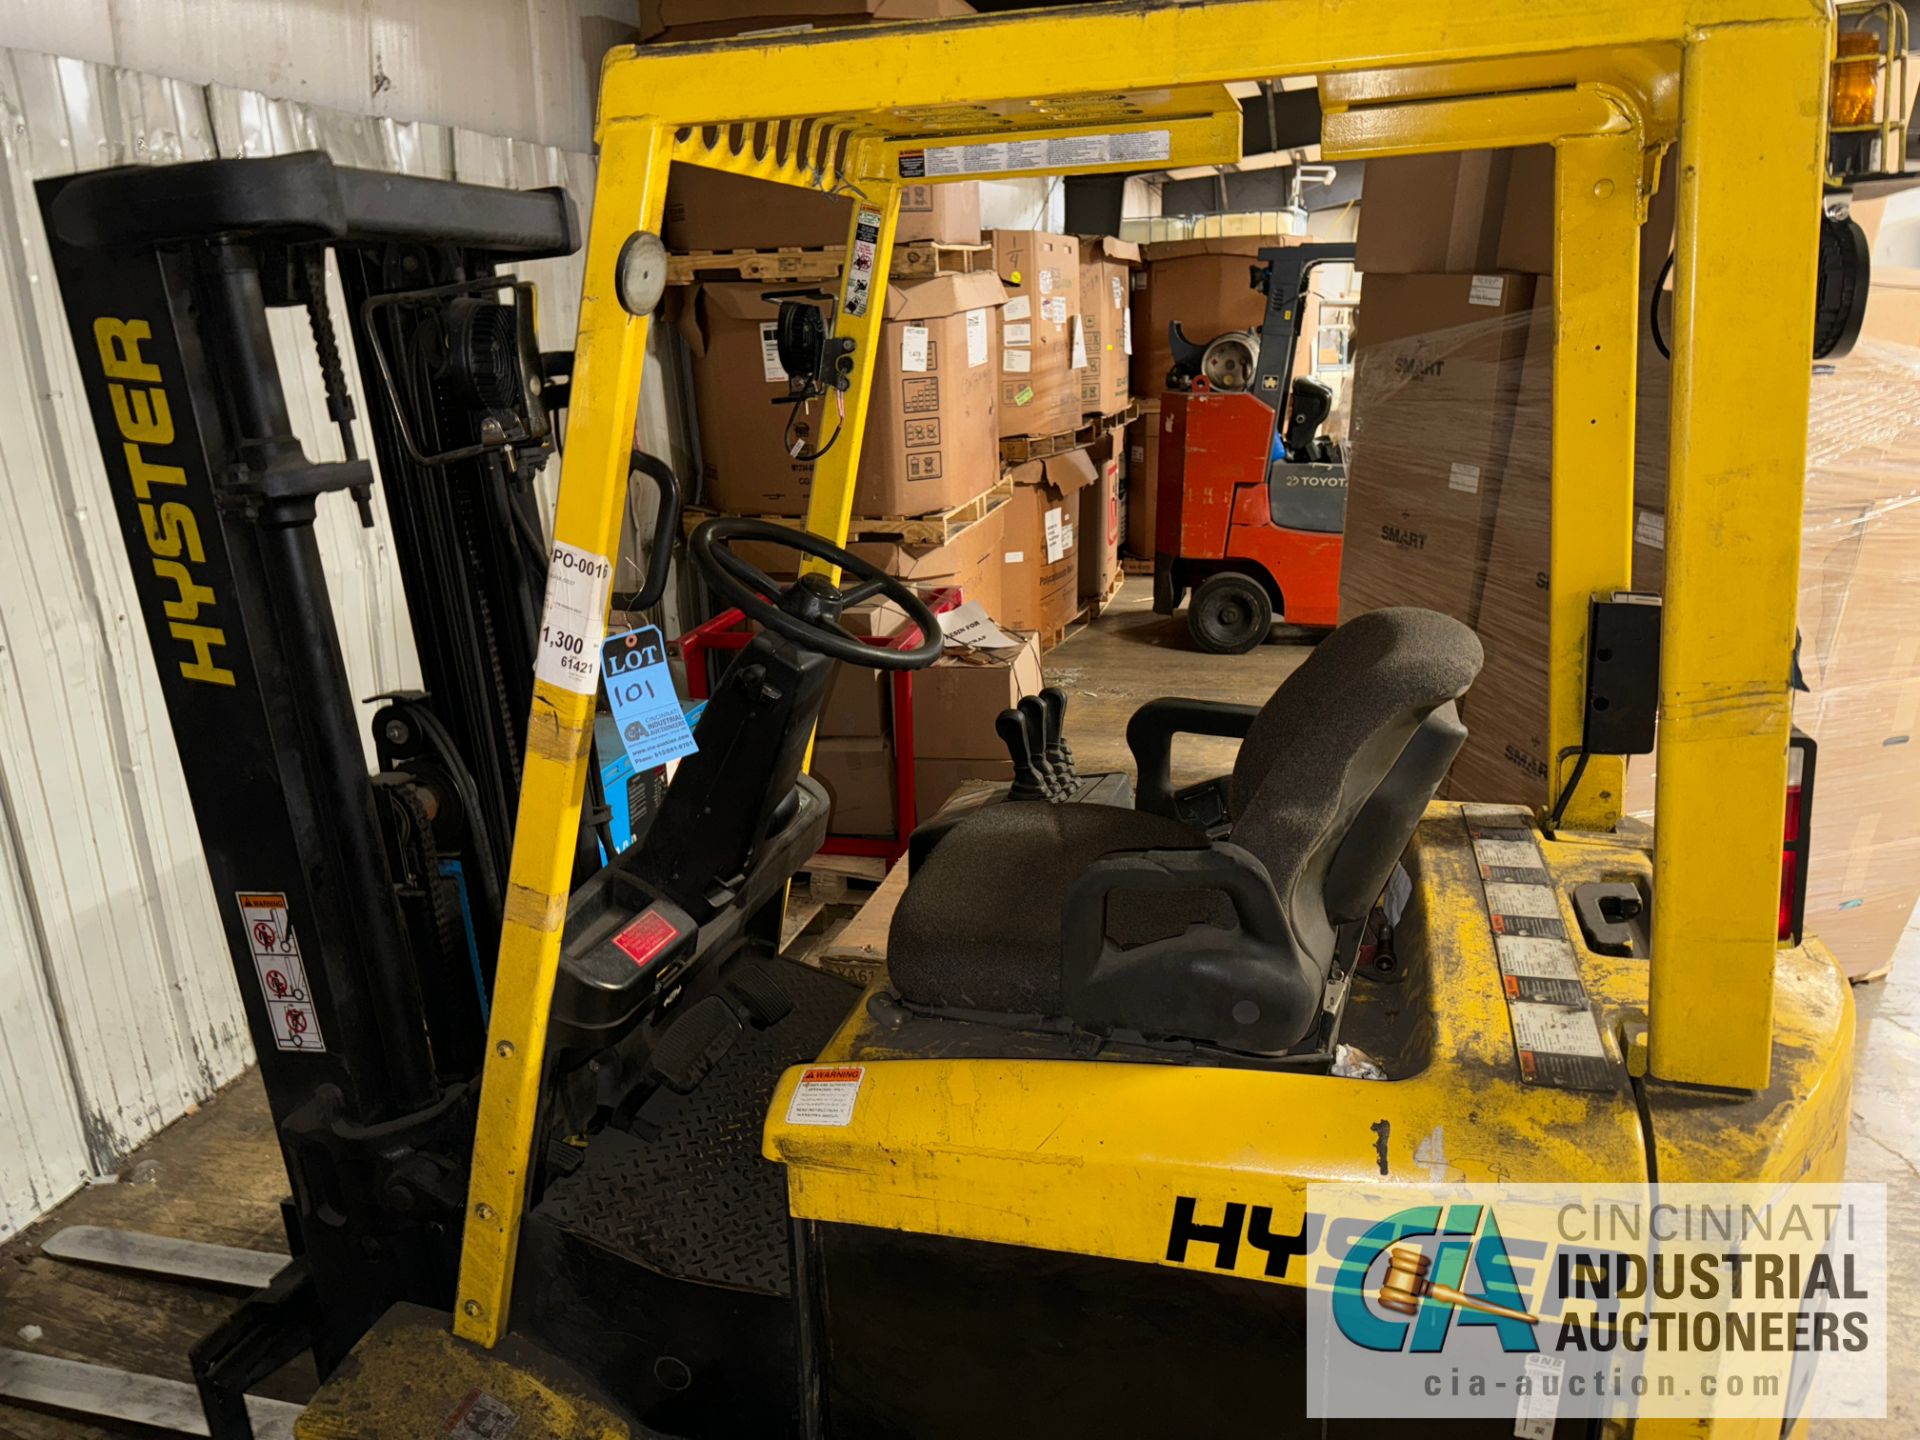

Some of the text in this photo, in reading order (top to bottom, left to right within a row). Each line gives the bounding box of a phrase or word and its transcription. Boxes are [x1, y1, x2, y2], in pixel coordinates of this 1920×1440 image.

[94, 317, 236, 687] HYSTER
[1381, 525, 1425, 550] SMART
[543, 626, 584, 655] 1,300
[561, 656, 593, 674] 61421
[609, 645, 657, 675] LOT
[614, 680, 655, 708] 101
[816, 1070, 859, 1079] WARNING
